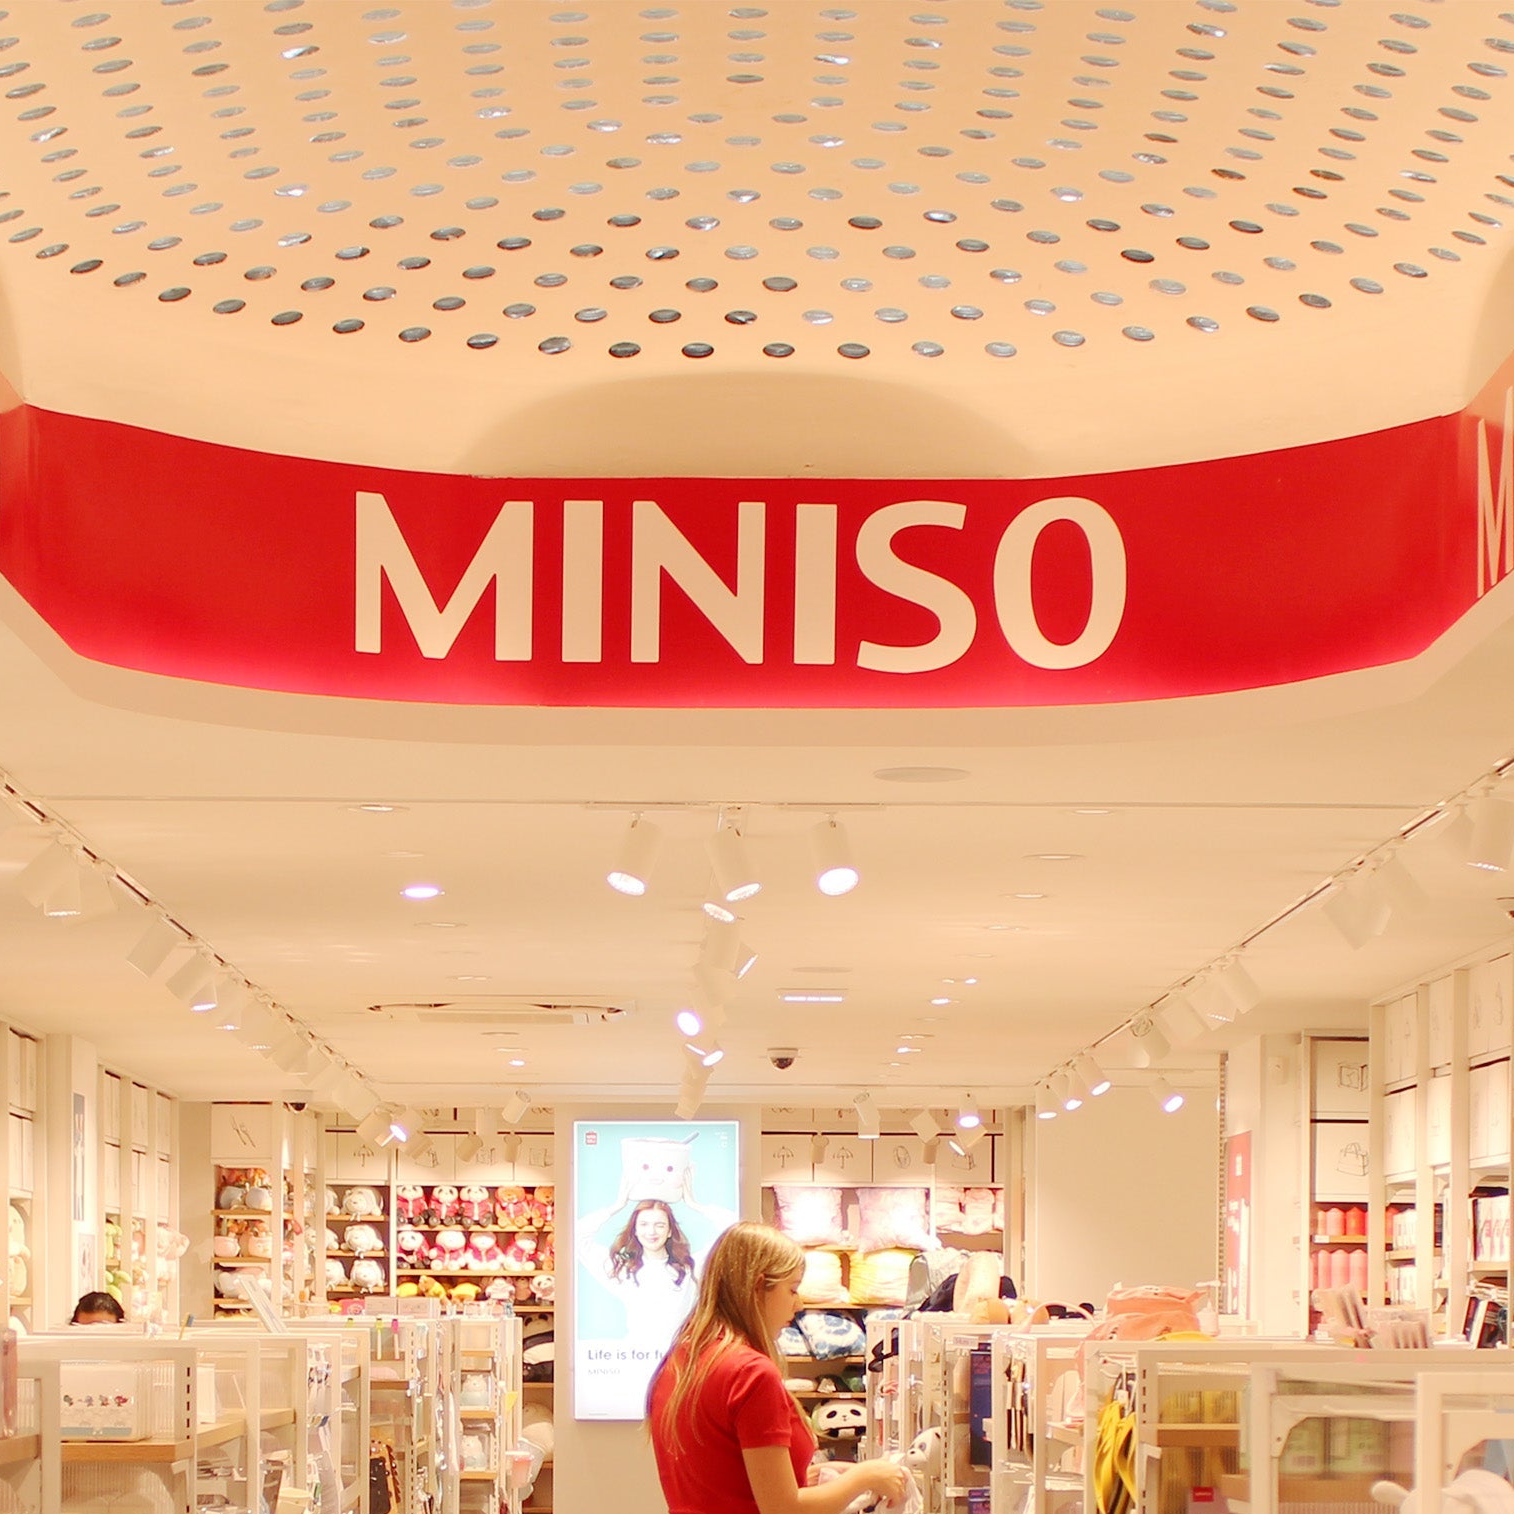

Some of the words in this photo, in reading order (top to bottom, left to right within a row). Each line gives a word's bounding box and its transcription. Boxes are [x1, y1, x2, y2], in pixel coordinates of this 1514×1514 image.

[355, 490, 1127, 674] MINISO
[588, 1349, 612, 1360] Life
[616, 1349, 627, 1360] is
[631, 1349, 650, 1360] for
[654, 1349, 667, 1360] fu
